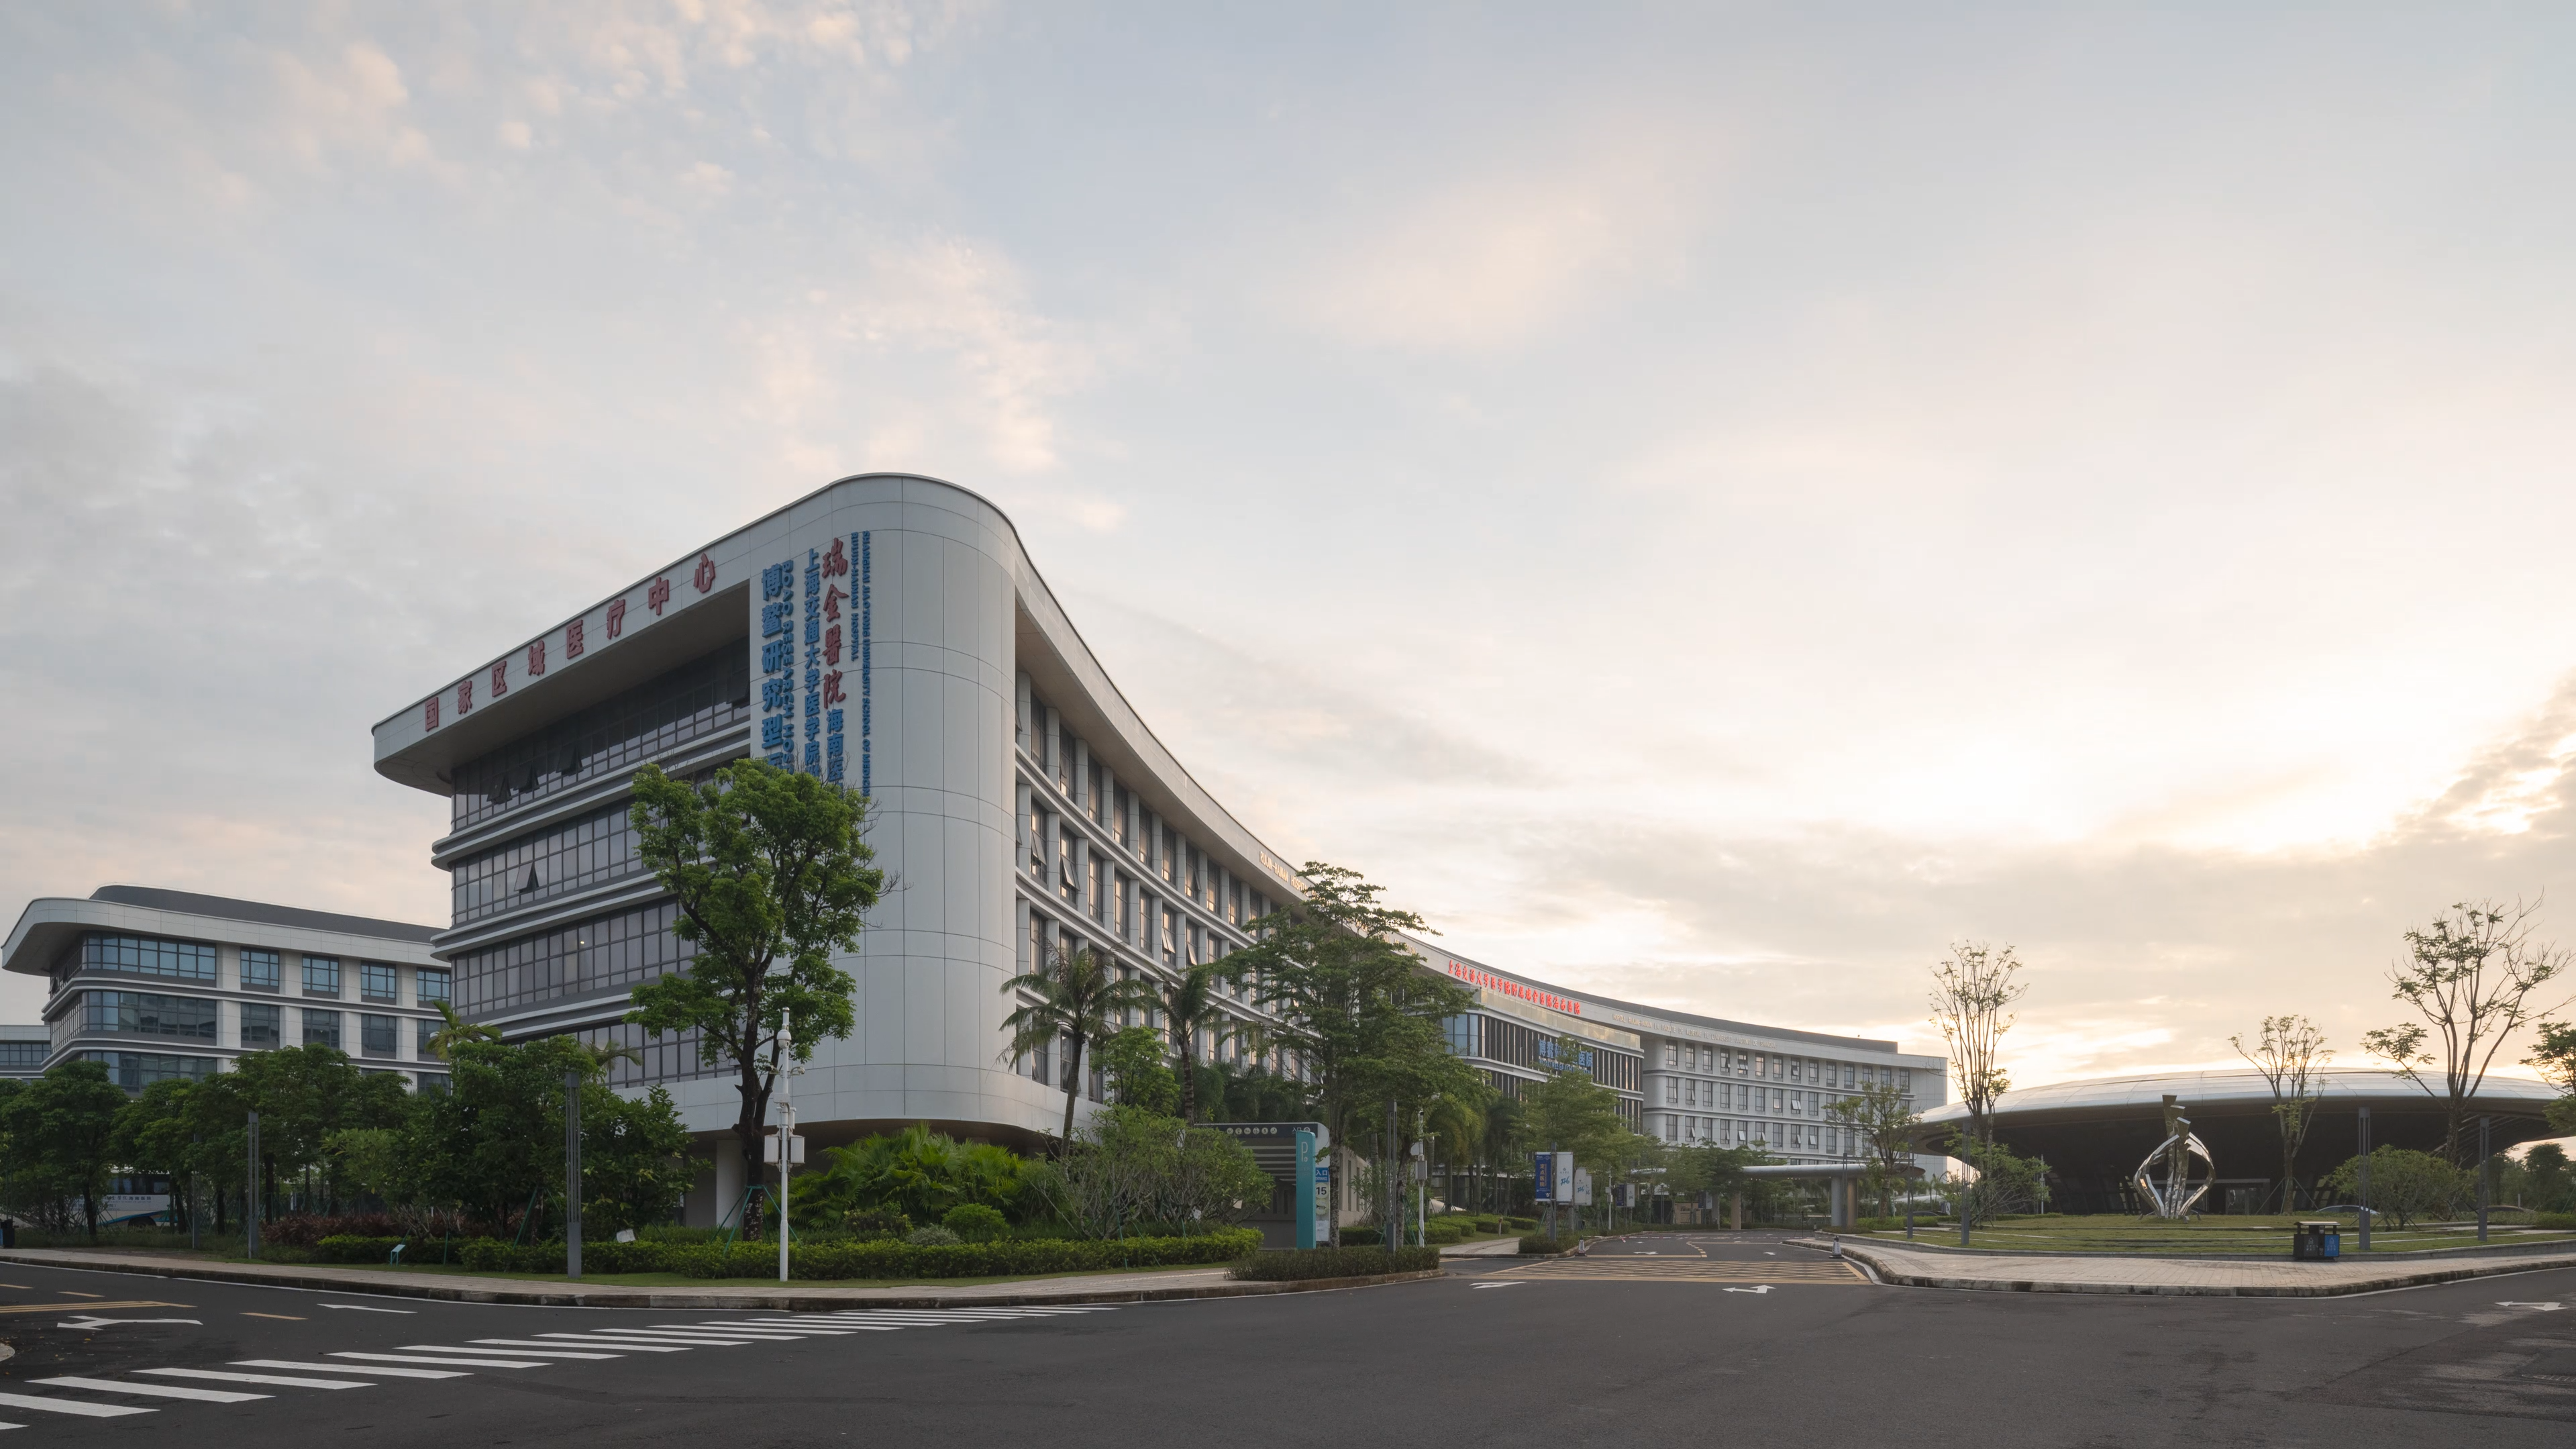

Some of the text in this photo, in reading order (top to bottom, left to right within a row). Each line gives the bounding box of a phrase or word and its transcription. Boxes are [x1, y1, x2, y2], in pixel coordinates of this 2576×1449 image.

[862, 530, 870, 583] SHANGHAI
[851, 532, 859, 662] RUIJIN-HAINAN HOSPITAL
[425, 552, 716, 732] 国家区域医疗中心
[782, 559, 795, 775] BOAO RESEARCH HOSP
[862, 638, 871, 697] UNIVERSITY
[862, 697, 871, 738] SCHOOL
[862, 739, 871, 752] OF
[862, 753, 871, 798] MEDICIN
[1301, 1142, 1308, 1162] P
[1316, 1187, 1327, 1195] 15
